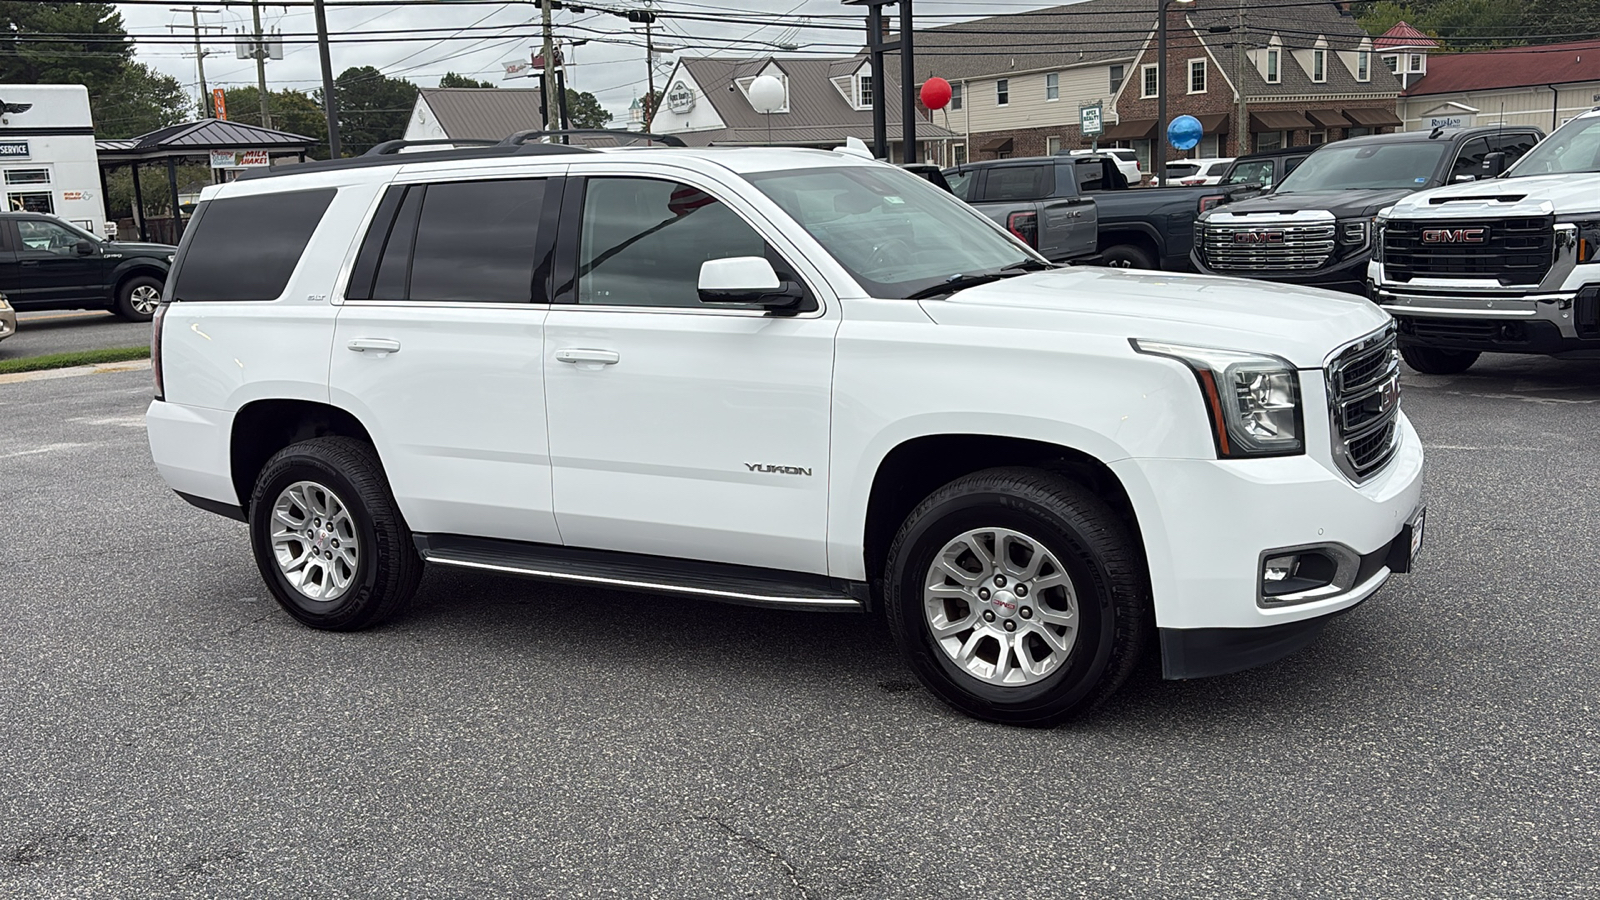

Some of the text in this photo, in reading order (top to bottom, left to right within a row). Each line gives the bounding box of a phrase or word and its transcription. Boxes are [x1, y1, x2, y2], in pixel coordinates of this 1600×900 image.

[0, 145, 27, 154] SERVICE
[241, 157, 267, 165] SHAKES
[1234, 232, 1283, 244] GMC
[1423, 228, 1484, 243] GMC
[743, 462, 813, 477] YUKON
[993, 599, 1016, 609] GMC
